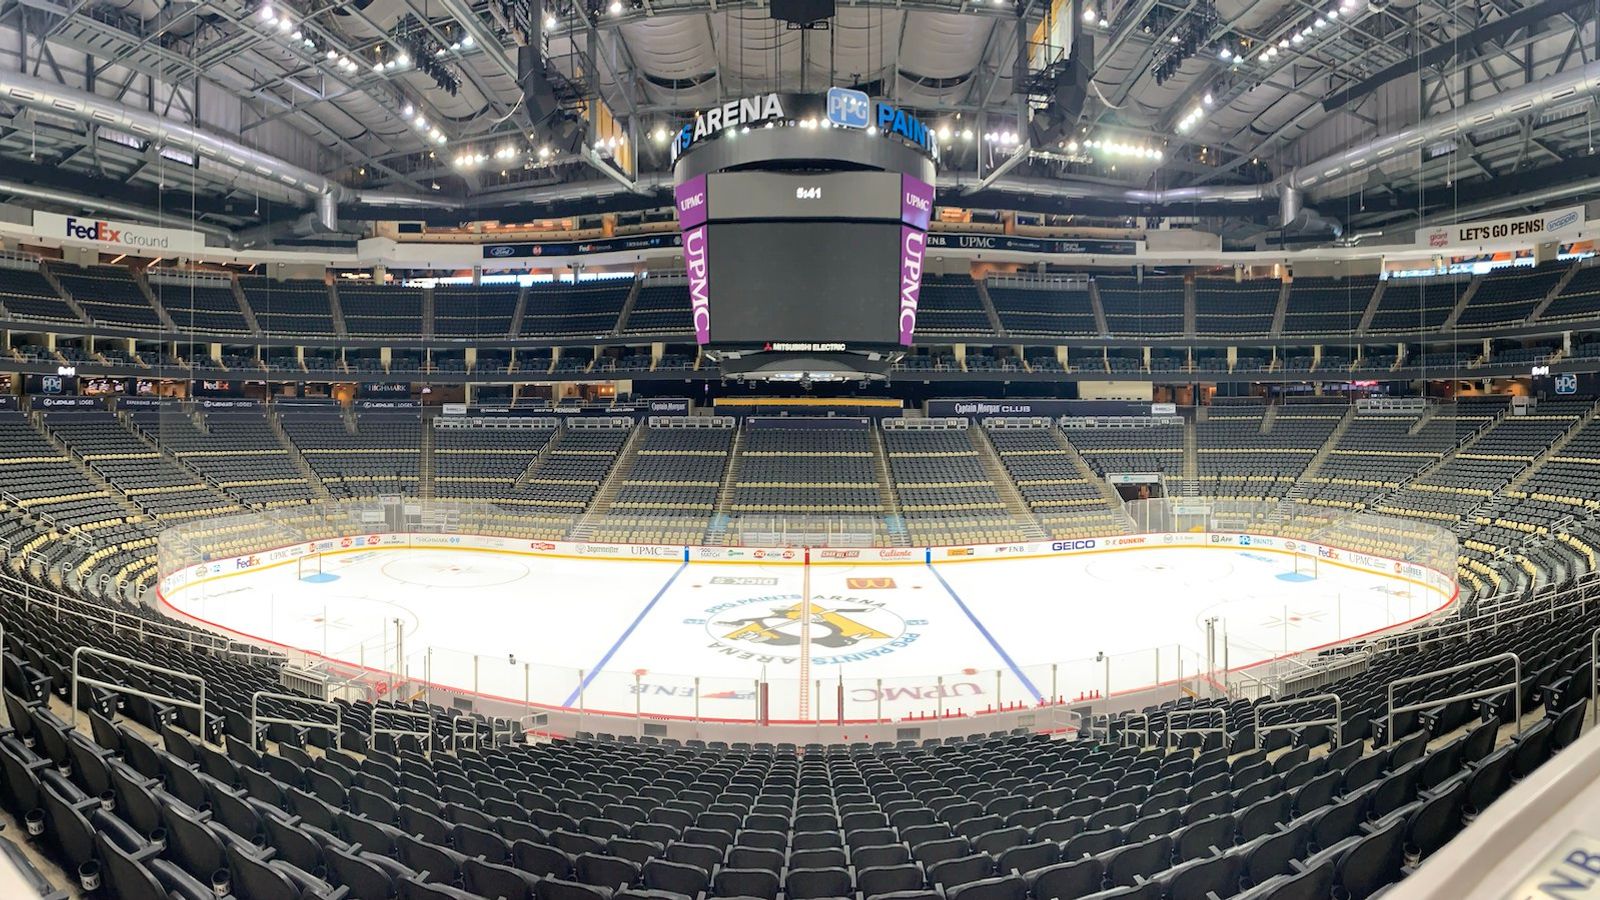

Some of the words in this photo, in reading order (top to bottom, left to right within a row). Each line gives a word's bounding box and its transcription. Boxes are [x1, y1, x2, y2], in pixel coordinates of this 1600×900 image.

[830, 94, 867, 121] PPG
[693, 93, 784, 141] ARENA
[877, 102, 940, 162] PAINTS
[681, 193, 703, 211] UPMC
[907, 193, 930, 211] UPMC
[66, 218, 120, 243] FedEx
[123, 230, 168, 248] Ground
[1459, 227, 1489, 241] LET'S
[1493, 224, 1507, 238] GO
[1511, 219, 1544, 236] PENS!
[494, 247, 511, 255] Ford
[960, 237, 996, 249] UPMC
[688, 228, 710, 332] UPMC
[900, 232, 924, 334] UPMC
[773, 343, 811, 351] MITSUBISHI
[813, 343, 846, 351] ELECTRIC
[43, 378, 62, 393] PPG
[203, 381, 229, 391] FedEx
[1556, 376, 1576, 391] PPG
[954, 403, 976, 414] Captain
[977, 403, 1000, 414] Morgan
[631, 546, 662, 556] UPMC
[880, 550, 912, 558] Caliente
[1052, 540, 1095, 552] GEICO
[1318, 547, 1339, 560] FedEx
[236, 556, 261, 569] FedEx
[1348, 554, 1373, 568] UPMC
[704, 601, 738, 614] PPG
[735, 594, 802, 607] PAINTS
[813, 594, 886, 609] ARENA
[889, 632, 920, 651] PPG
[706, 641, 802, 665] ARENA
[812, 646, 899, 666] PAINTS
[849, 682, 986, 702] UPMC
